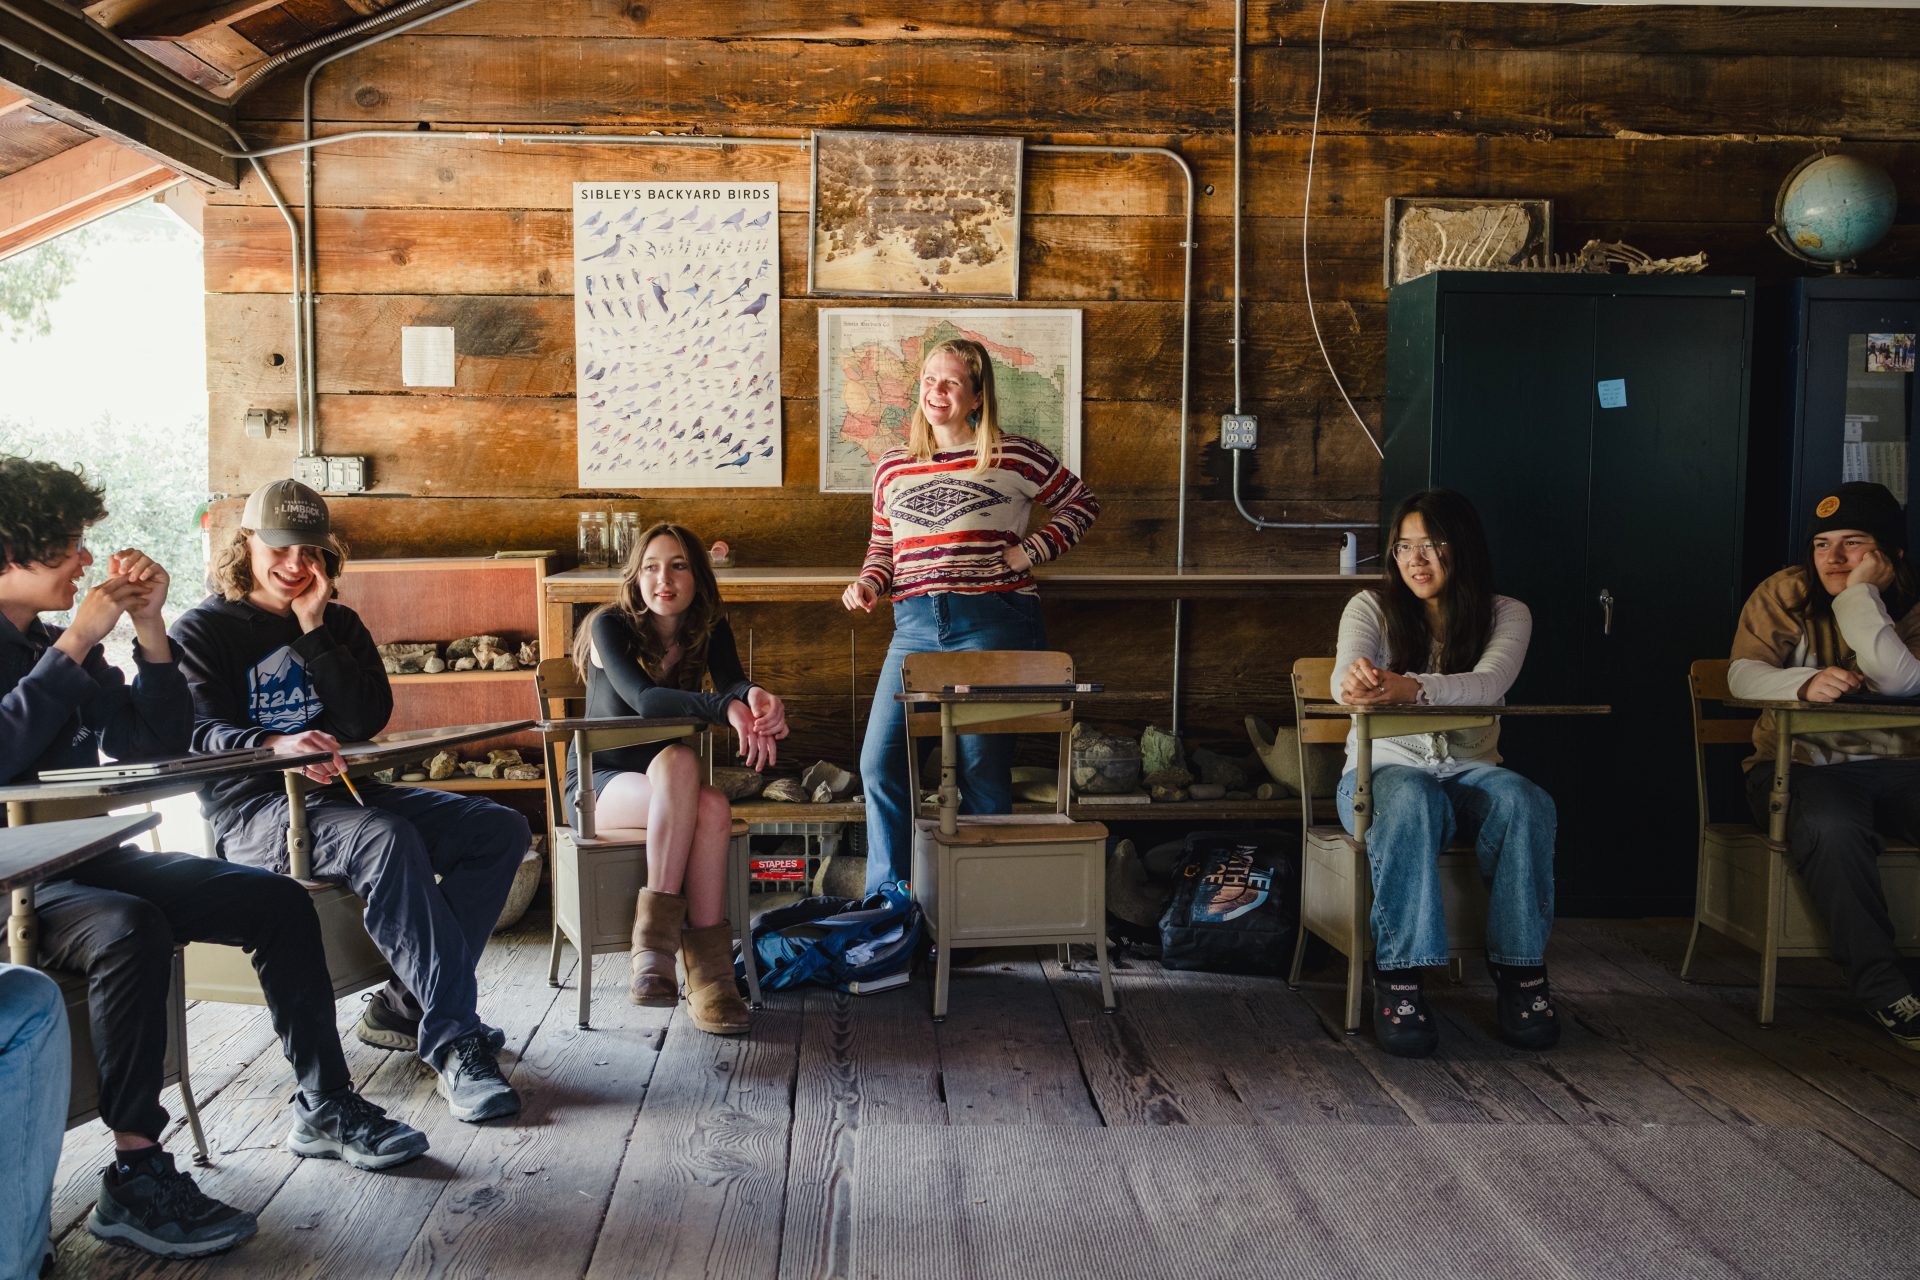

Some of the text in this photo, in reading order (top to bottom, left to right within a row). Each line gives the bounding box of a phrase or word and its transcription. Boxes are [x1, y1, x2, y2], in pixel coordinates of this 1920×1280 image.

[581, 189, 770, 200] SIBLEY'S BACKYARD BIRDS
[281, 503, 320, 516] LIMBACK
[758, 859, 798, 869] STAPLES
